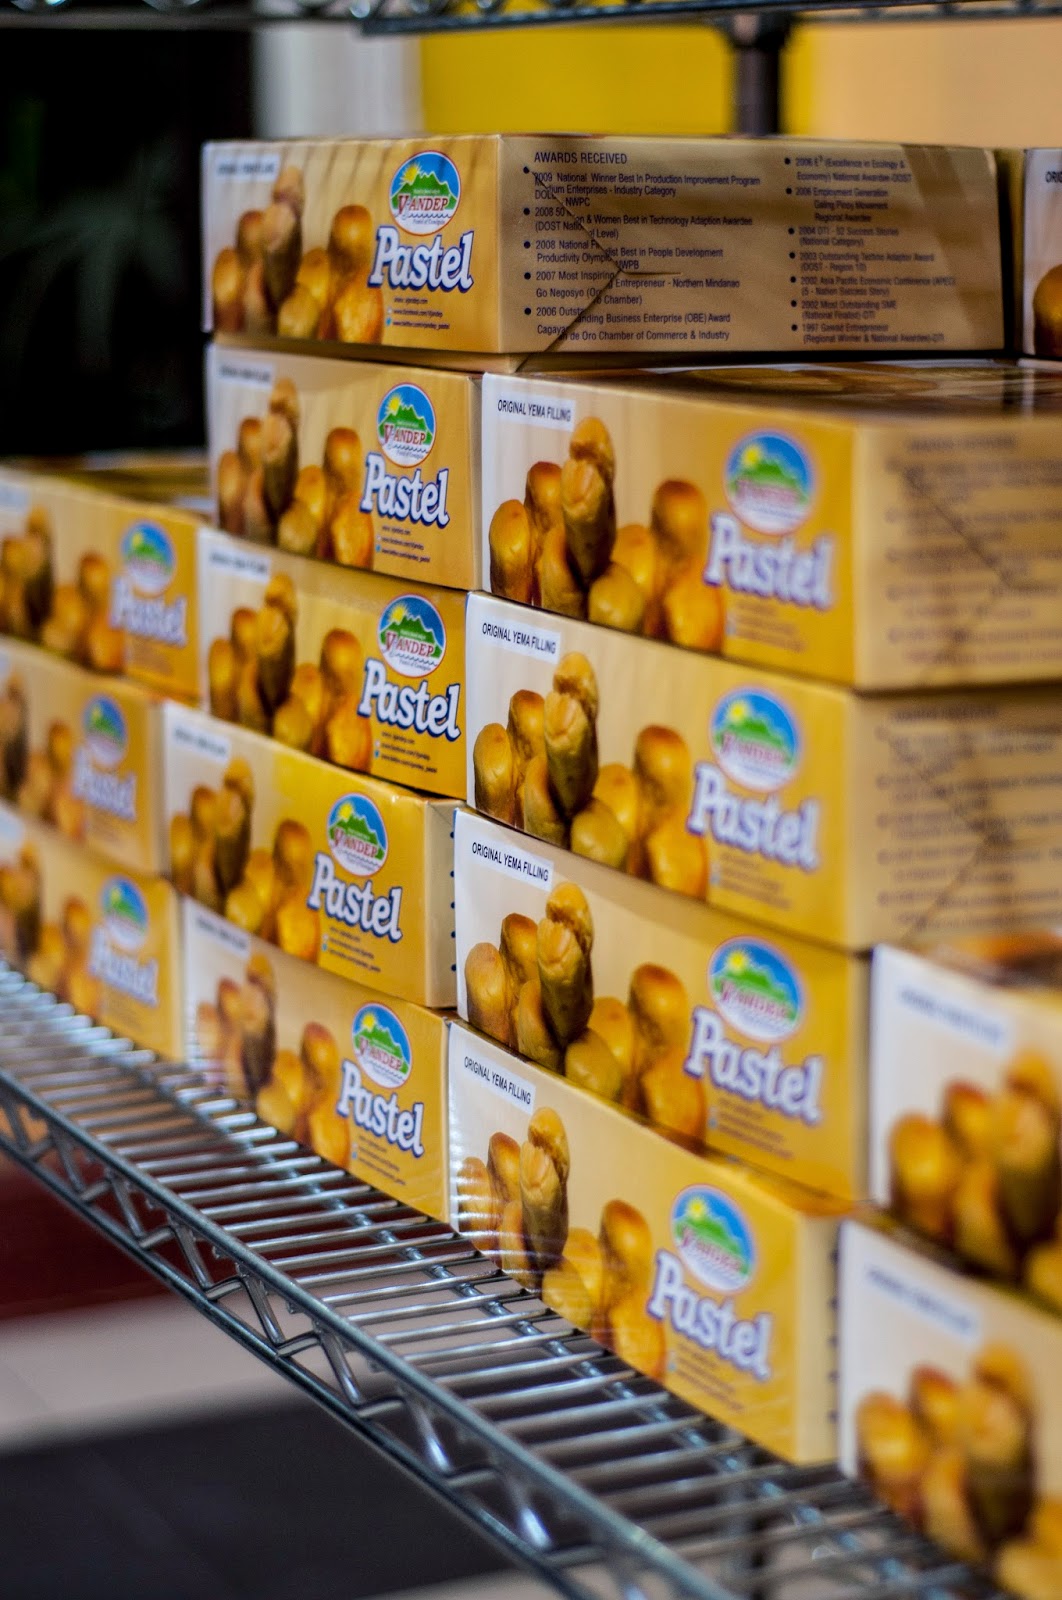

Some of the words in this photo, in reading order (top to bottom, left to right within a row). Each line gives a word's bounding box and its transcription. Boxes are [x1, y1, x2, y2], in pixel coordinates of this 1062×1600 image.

[534, 152, 578, 163] AWARDS
[581, 152, 627, 164] RECEIVED
[557, 172, 587, 182] National
[591, 173, 616, 183] Winner
[619, 173, 635, 183] Best
[645, 174, 682, 184] Production
[684, 175, 729, 186] Improvement
[731, 175, 760, 187] Program
[1045, 171, 1062, 184] ORI
[565, 197, 590, 206] NWPC
[567, 185, 607, 195] Enterprises
[614, 185, 642, 196] Industry
[645, 186, 676, 197] Category
[555, 207, 565, 216] 50
[586, 216, 592, 224] &
[593, 215, 620, 224] Women
[623, 215, 639, 224] Best
[650, 215, 688, 227] Technology
[535, 221, 560, 232] (DOST
[596, 229, 619, 240] Level)
[367, 225, 474, 293] Pastel
[536, 240, 556, 249] 2008
[558, 240, 589, 249] National
[620, 247, 637, 257] Best
[648, 247, 673, 259] People
[675, 247, 723, 258] Development
[537, 252, 580, 264] Productivity
[536, 271, 556, 280] 2007
[558, 271, 578, 280] Most
[616, 279, 665, 289] Entrepreneur
[672, 279, 704, 288] Northern
[705, 279, 740, 288] Mindanao
[536, 288, 548, 298] Go
[550, 288, 584, 298] Negosyo
[604, 294, 643, 305] Chamber)
[536, 307, 557, 316] 2006
[606, 313, 641, 323] Business
[643, 313, 682, 324] Enterprise
[708, 313, 731, 323] Award
[570, 331, 580, 340] de
[582, 331, 597, 340] Oro
[598, 331, 634, 340] Chamber
[636, 330, 644, 340] of
[646, 330, 688, 340] Commerce
[690, 330, 696, 340] &
[698, 330, 730, 341] Industry
[497, 399, 526, 416] ORIGINAL
[528, 403, 546, 418] YEMA
[547, 406, 571, 422] FILLING
[359, 452, 450, 529] Pastel
[703, 511, 835, 610] Pastel
[482, 622, 511, 642] ORIGINAL
[513, 630, 530, 647] YEMA
[531, 636, 556, 654] FILLING
[356, 657, 462, 742] Pastel
[686, 760, 820, 871] Pastel
[472, 842, 502, 864] ORIGINAL
[504, 853, 522, 872] YEMA
[523, 861, 549, 882] FILLING
[306, 852, 403, 943] Pastel
[683, 1006, 825, 1126] Pastel
[464, 1056, 490, 1082] ORIGINAL
[492, 1071, 508, 1092] YEMA
[508, 1081, 531, 1105] FILLING
[336, 1058, 424, 1158] Pastel
[647, 1247, 773, 1382] Pastel
